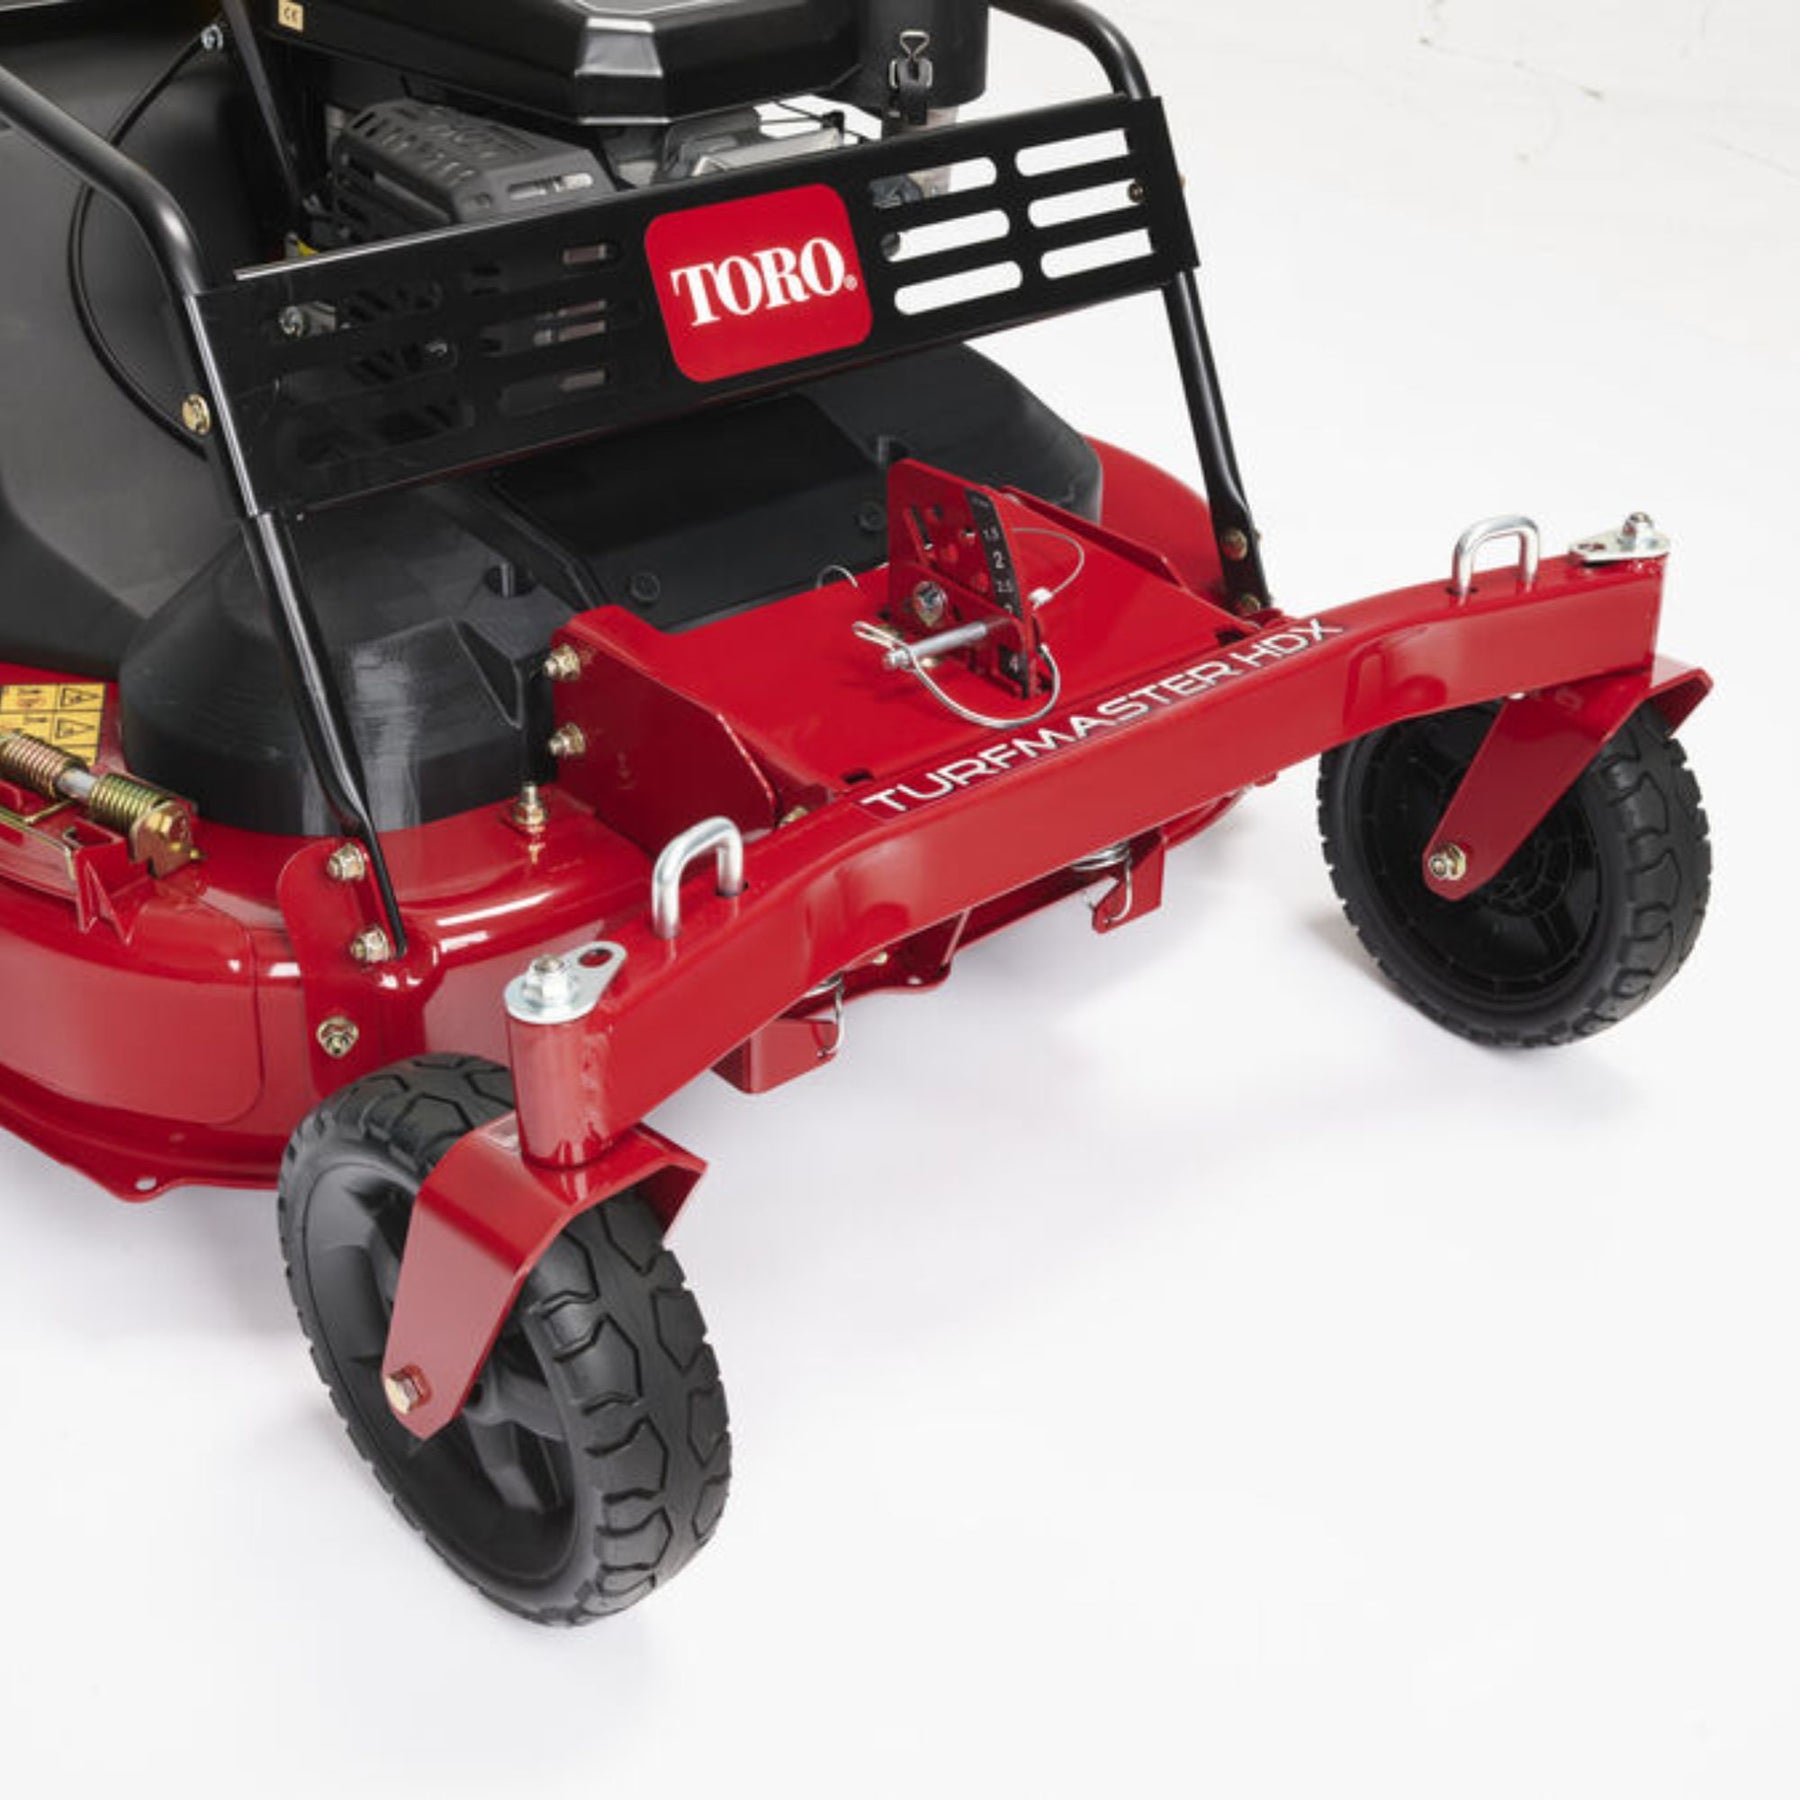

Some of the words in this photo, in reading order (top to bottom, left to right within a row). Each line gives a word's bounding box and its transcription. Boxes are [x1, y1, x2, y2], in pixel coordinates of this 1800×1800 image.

[992, 551, 1004, 569] 2
[861, 660, 1243, 812] TURFMASTER
[1229, 618, 1344, 668] HDX
